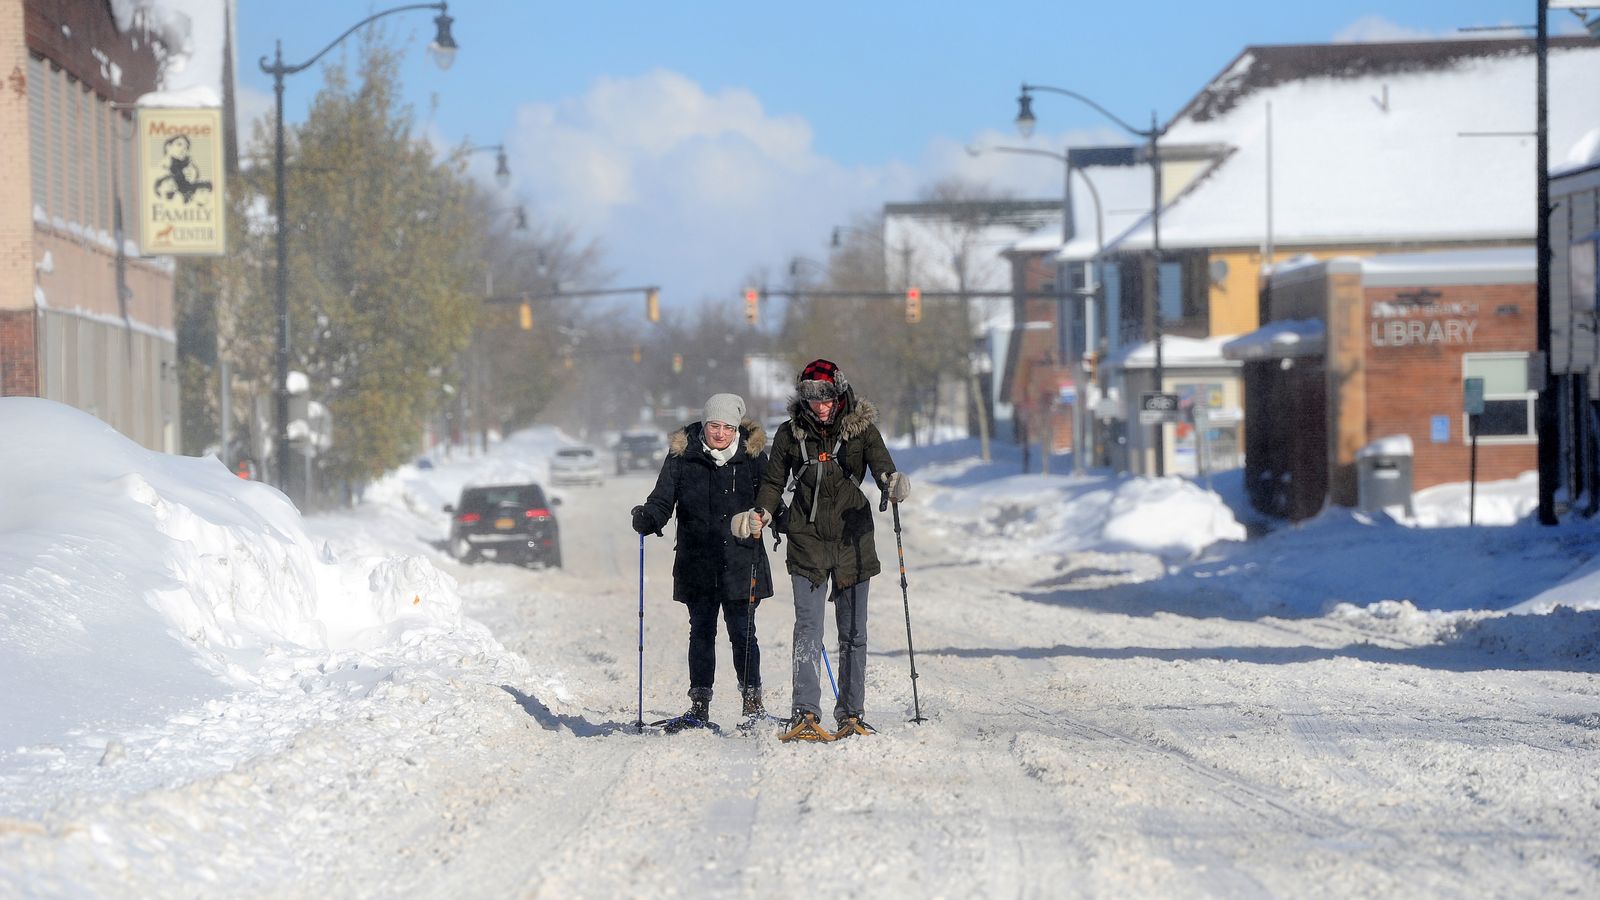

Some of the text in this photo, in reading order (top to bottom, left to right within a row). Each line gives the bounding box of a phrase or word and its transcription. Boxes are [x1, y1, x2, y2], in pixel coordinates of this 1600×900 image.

[149, 122, 212, 136] Moose
[152, 203, 213, 222] FAMILY
[173, 226, 215, 241] CENTER
[1371, 319, 1479, 347] LIBRARY
